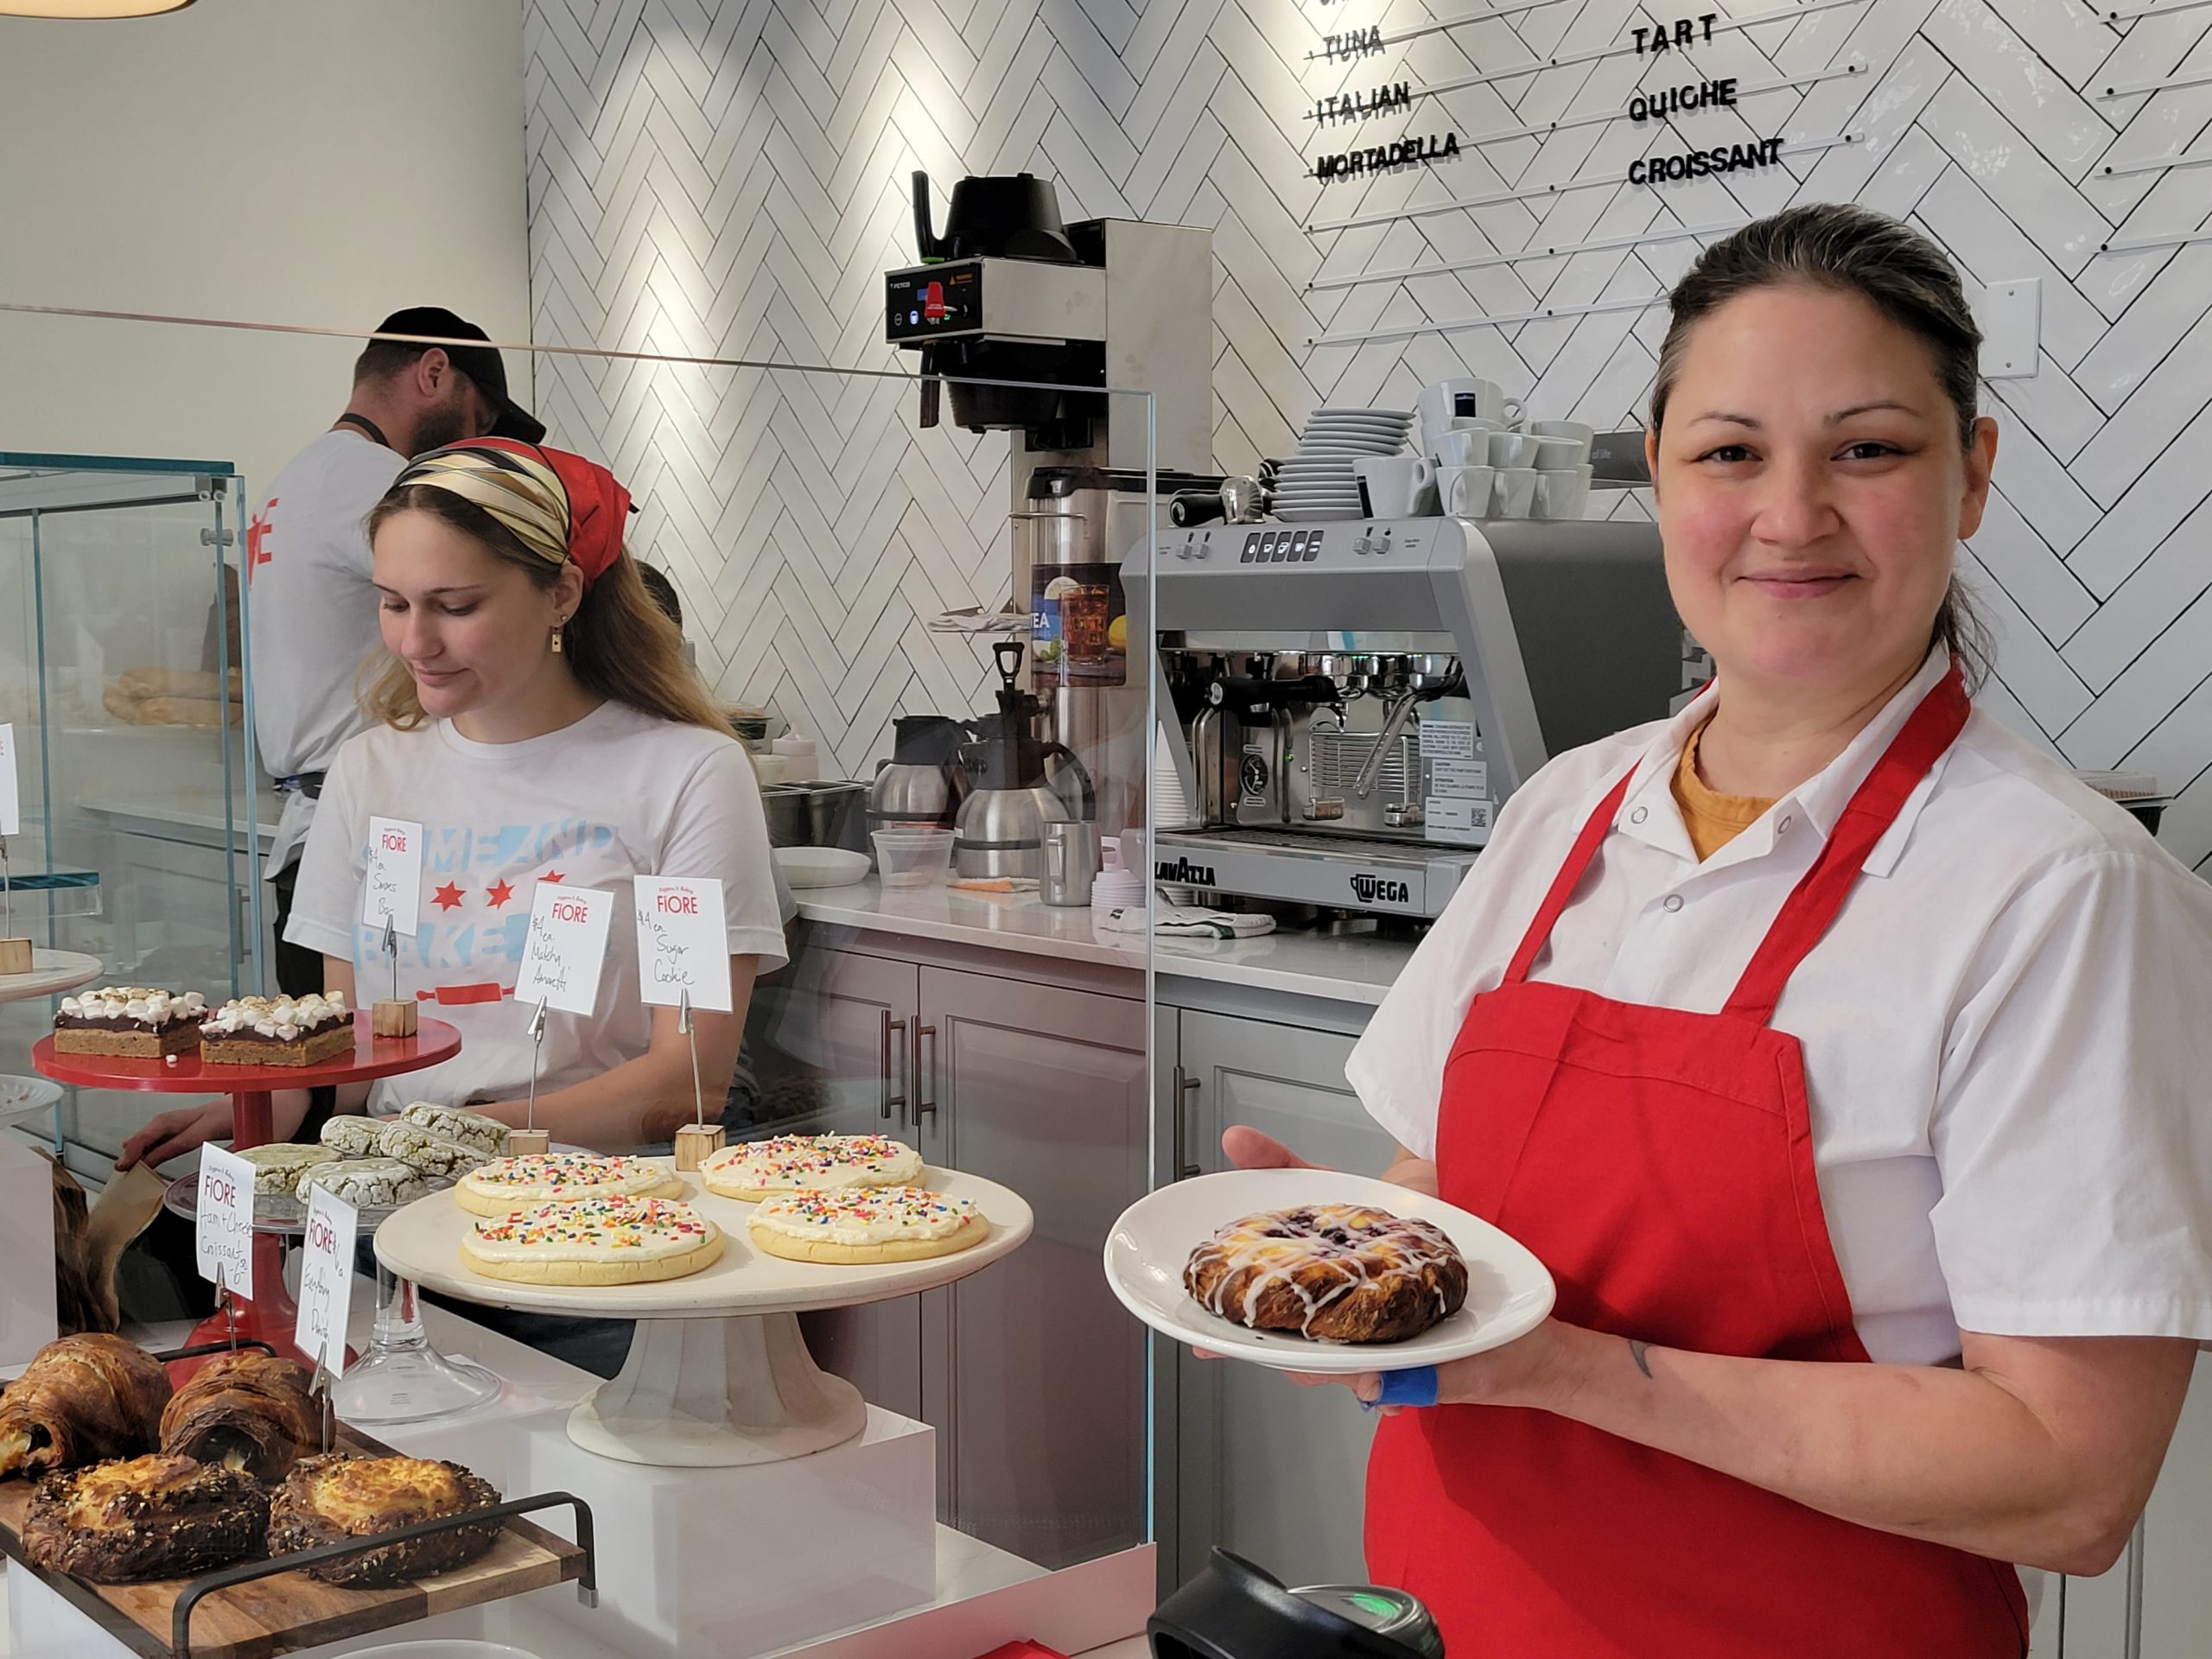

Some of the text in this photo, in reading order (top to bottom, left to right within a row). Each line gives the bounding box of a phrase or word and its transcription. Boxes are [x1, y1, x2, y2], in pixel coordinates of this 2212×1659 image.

[1323, 25, 1383, 59] TUNA
[1631, 13, 1717, 54] TART
[1316, 81, 1410, 123] ITALIAN
[1629, 78, 1738, 122] QUICHE
[1317, 132, 1460, 179] MORTADELLA
[1629, 137, 1784, 185] CROISSANT
[1356, 874, 1409, 904] WEGA
[656, 934, 690, 965] Sugar
[653, 958, 696, 986] Cookie
[200, 1200, 220, 1230] Ham
